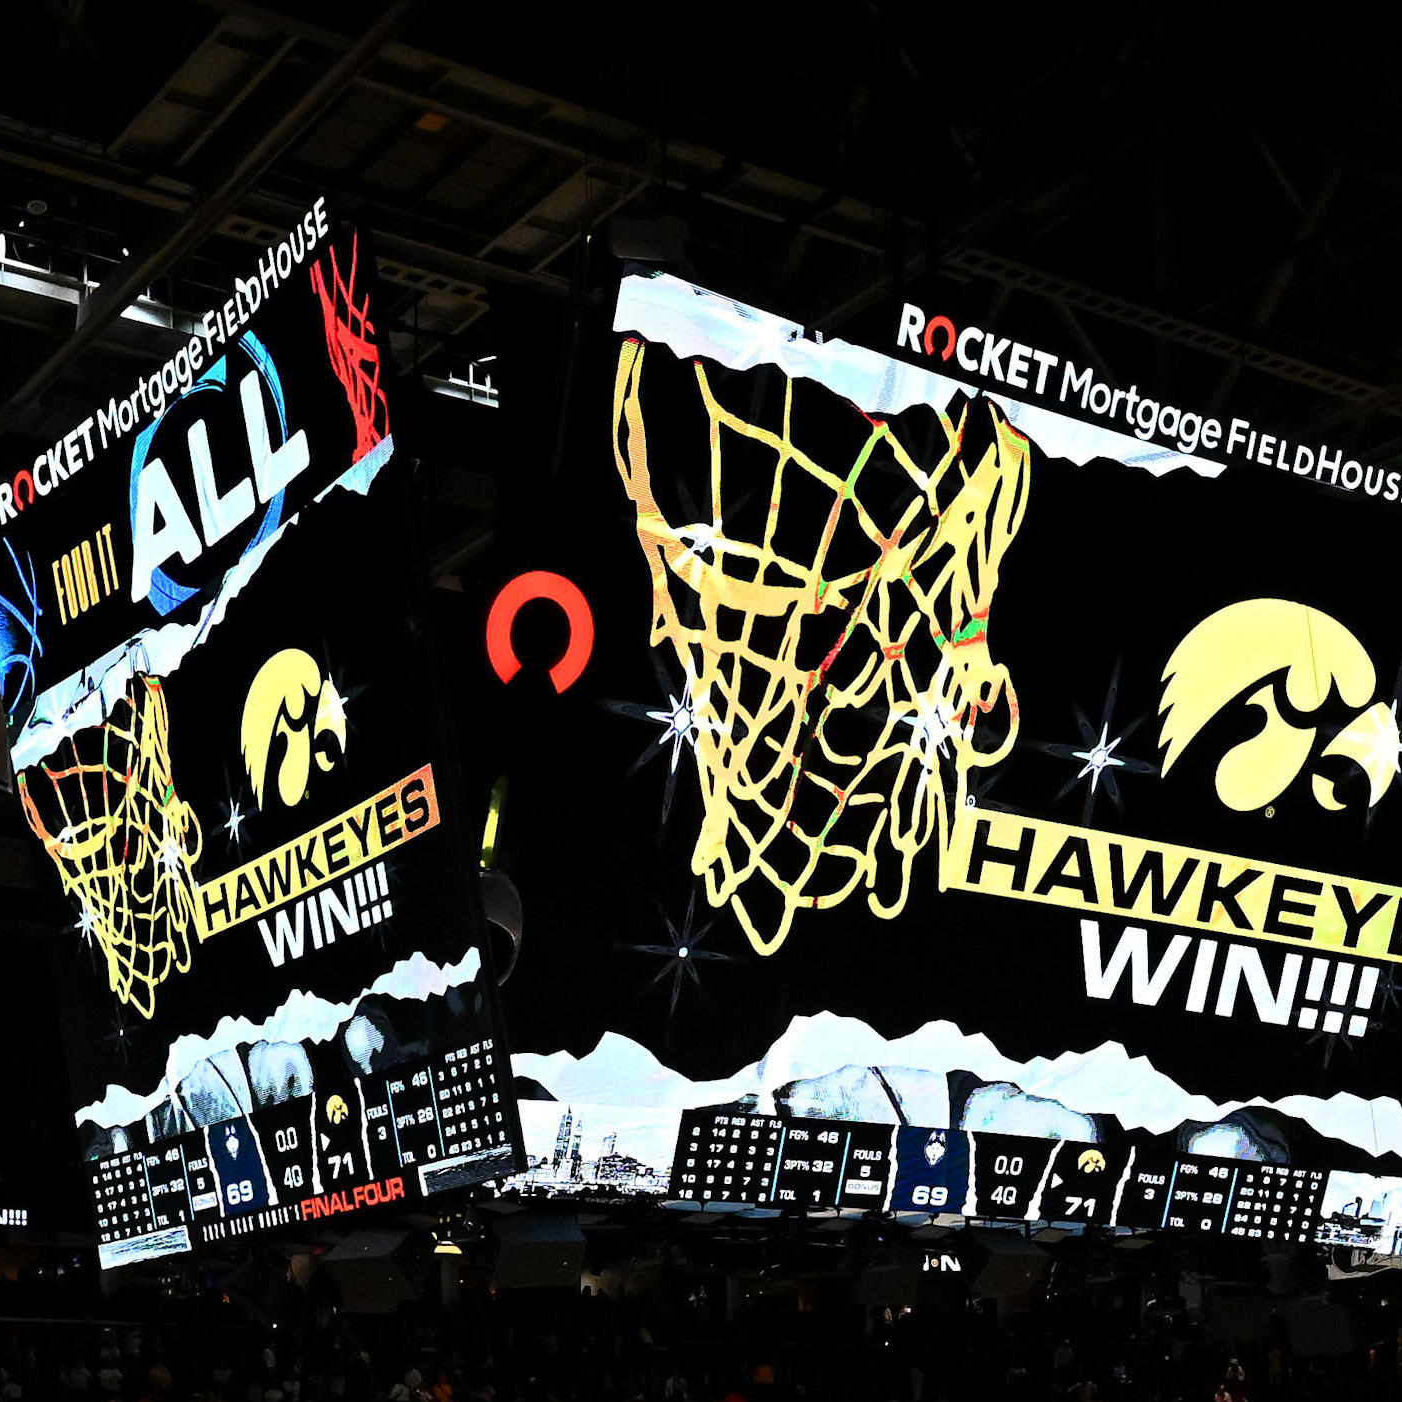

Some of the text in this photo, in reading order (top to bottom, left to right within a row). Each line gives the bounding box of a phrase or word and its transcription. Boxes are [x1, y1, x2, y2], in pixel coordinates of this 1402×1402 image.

[897, 302, 1059, 395] ROCKET
[1060, 360, 1225, 454] Mortgage
[96, 334, 204, 449] Mortgage
[130, 369, 311, 604] ALL
[52, 522, 119, 626] FOUR IT
[201, 772, 433, 938] HAWKEYES
[258, 861, 394, 968] WIN!!!
[1079, 919, 1381, 1037] WIN!!!
[461, 1063, 468, 1073] 7
[412, 1071, 428, 1087] 46
[452, 1085, 462, 1096] 11
[480, 1096, 487, 1107] 7
[366, 1104, 389, 1120] FOULS
[417, 1106, 434, 1124] 28
[715, 1116, 729, 1125] PTS
[750, 1119, 765, 1127] AST
[769, 1120, 782, 1128] FLS
[275, 1126, 298, 1152] 0.0
[377, 1126, 387, 1140] 3
[712, 1128, 726, 1137] 14
[789, 1130, 839, 1144] FG% 46
[427, 1144, 437, 1159] 0
[709, 1143, 723, 1152] 17
[853, 1149, 882, 1160] FOULS
[165, 1148, 180, 1162] 46
[327, 1152, 355, 1179] 71
[707, 1159, 721, 1168] 17
[784, 1160, 834, 1173] 3PT% 32
[994, 1155, 1023, 1176] 0.0
[283, 1165, 304, 1189] 4Q
[860, 1165, 871, 1177] 5
[1180, 1164, 1229, 1179] FG% 46
[170, 1178, 185, 1192] 32
[682, 1174, 751, 1185] 10 7
[1138, 1173, 1165, 1185] FOULS
[226, 1179, 254, 1205] 69
[300, 1176, 406, 1221] FINAL FOUR
[722, 1191, 730, 1200] 7
[779, 1190, 821, 1202] TOL 1
[912, 1185, 948, 1206] 69
[991, 1186, 1017, 1205] 4Q
[1144, 1188, 1155, 1200] 3
[1174, 1190, 1198, 1201] 3PT%
[1065, 1196, 1096, 1217] 71
[1170, 1217, 1212, 1230] TOL 0
